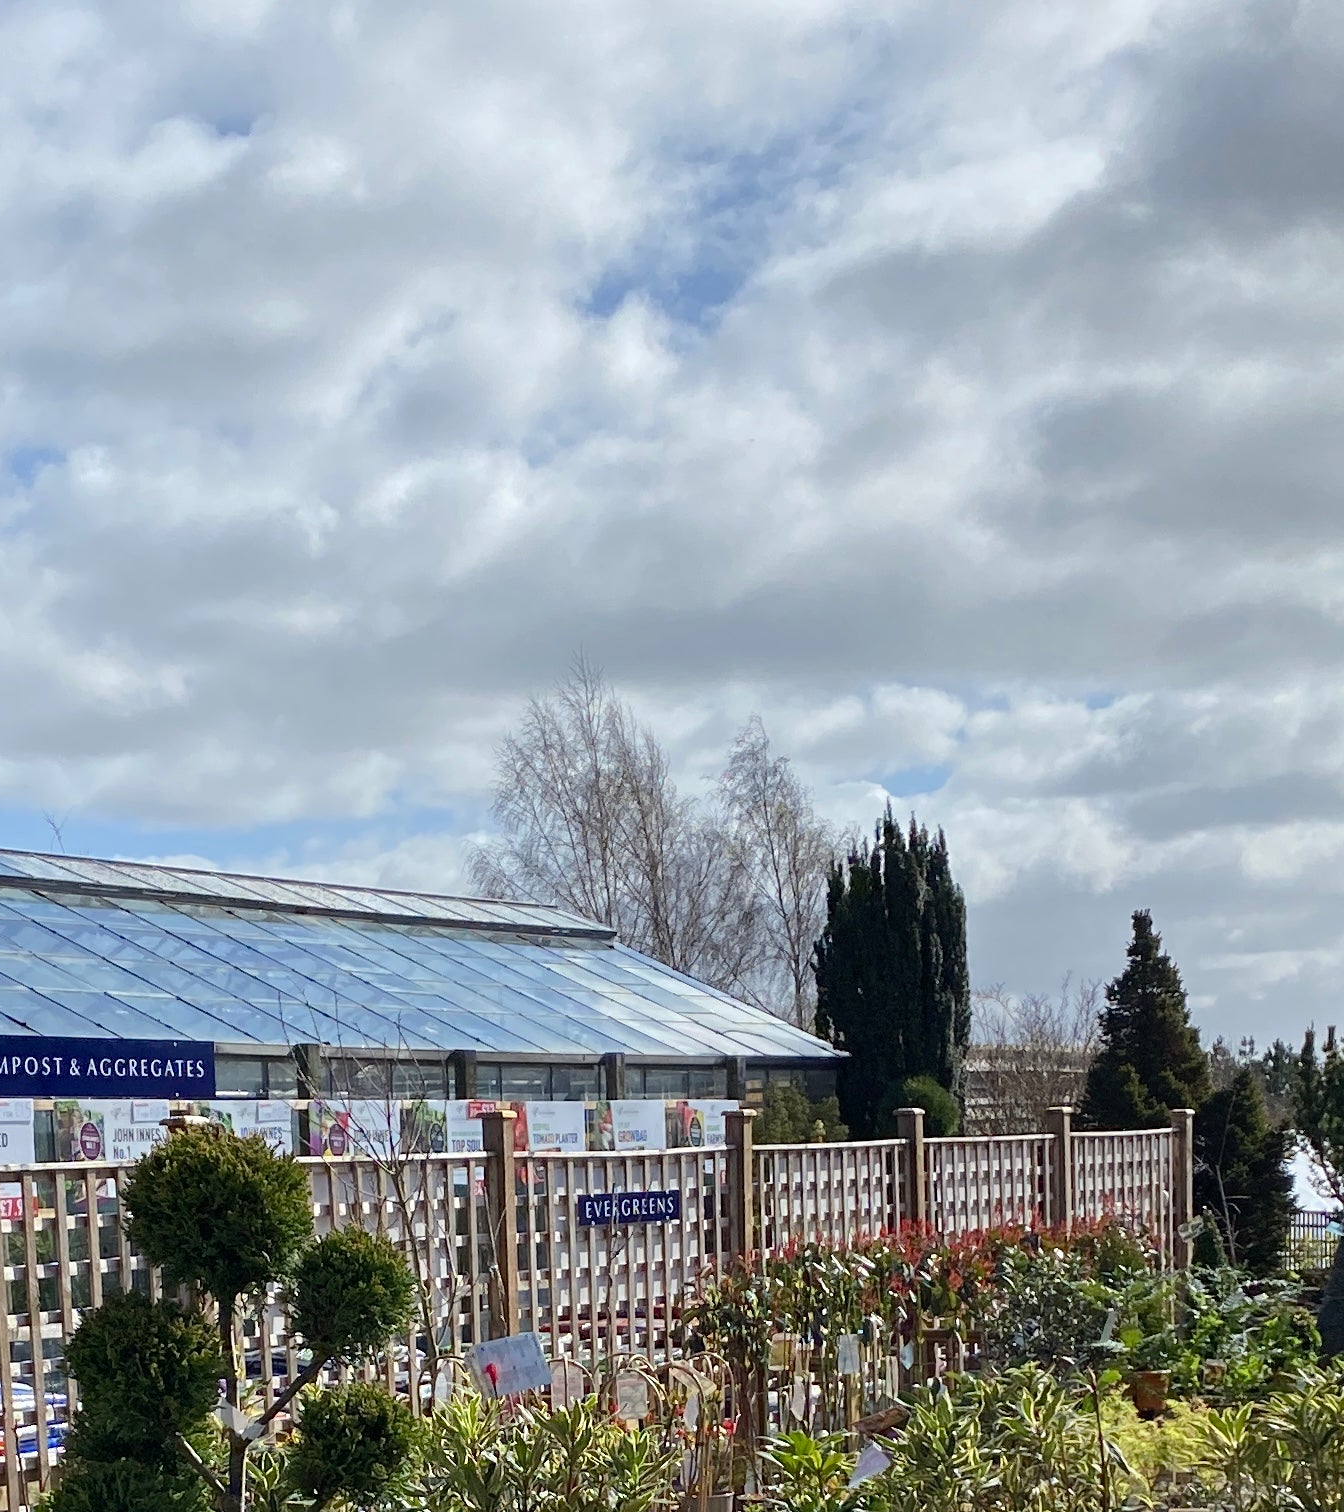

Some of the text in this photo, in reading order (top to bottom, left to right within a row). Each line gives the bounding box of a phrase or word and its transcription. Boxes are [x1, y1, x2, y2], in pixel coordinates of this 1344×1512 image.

[69, 1060, 80, 1076] &
[87, 1058, 205, 1078] AGGREGATES
[113, 1127, 161, 1142] JOHN INNES
[556, 1133, 578, 1144] PLANTER
[618, 1130, 648, 1143] GROWBAG
[452, 1139, 465, 1152] TOP
[585, 1197, 674, 1219] EVERGREENS
